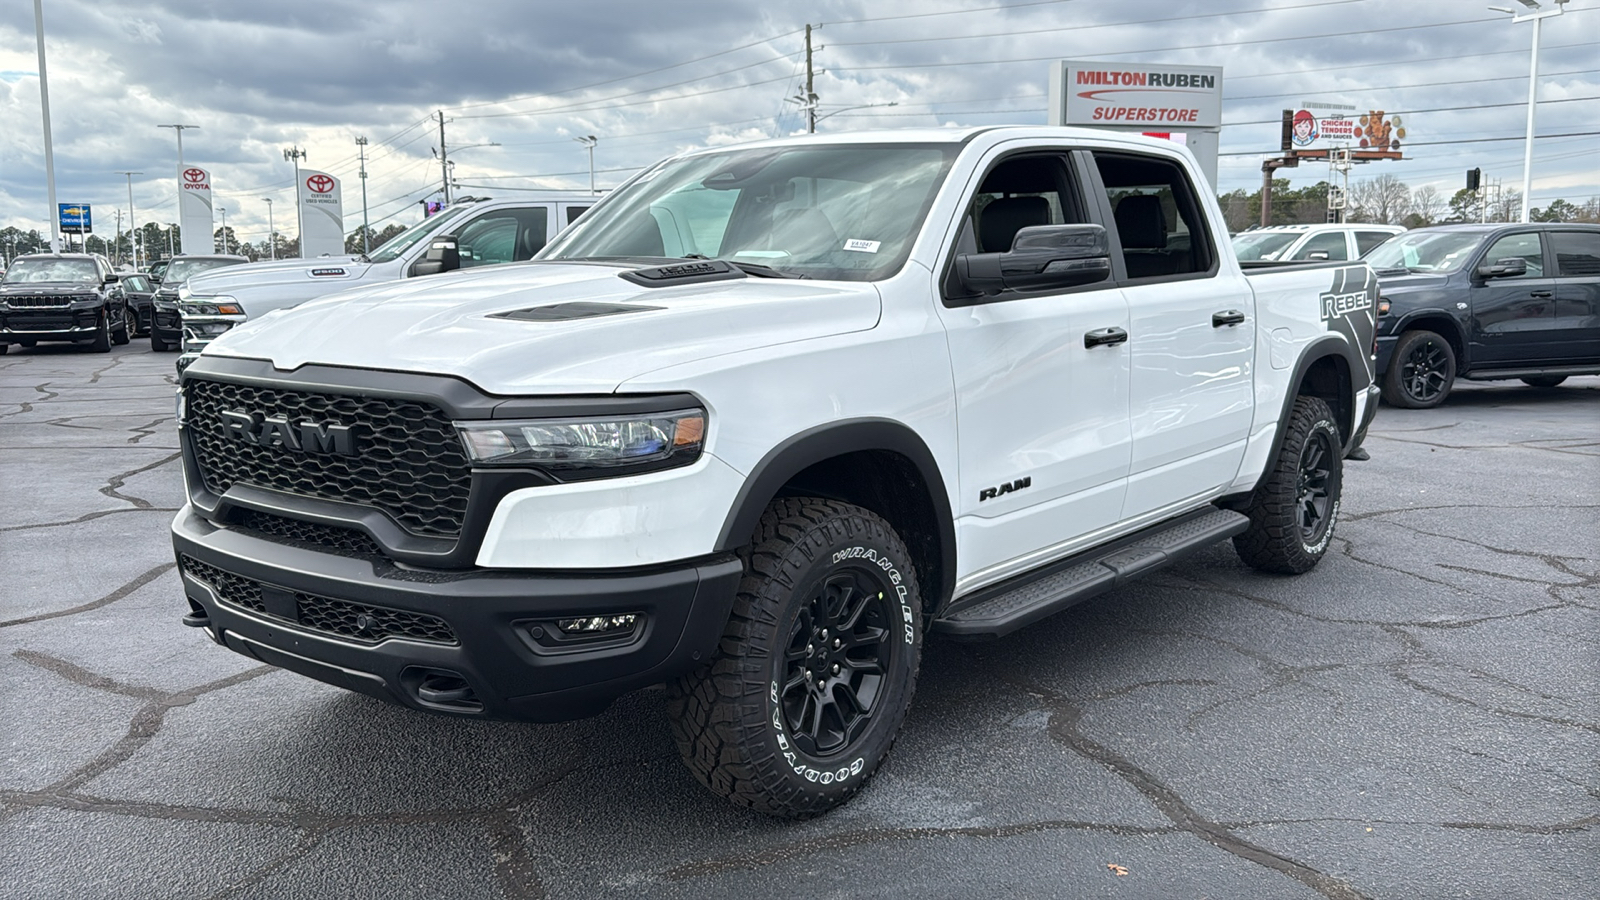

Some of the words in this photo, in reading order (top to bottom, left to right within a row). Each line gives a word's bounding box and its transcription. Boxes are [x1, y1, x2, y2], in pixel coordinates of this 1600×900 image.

[1077, 71, 1146, 86] MILTON
[1148, 73, 1215, 88] RUBEN
[1092, 107, 1199, 122] SUPERSTORE
[1320, 290, 1372, 319] REBEL
[221, 410, 353, 456] RAM
[979, 476, 1031, 503] RAM
[832, 546, 915, 645] WRANGLER
[770, 680, 865, 785] GOODYEAR
